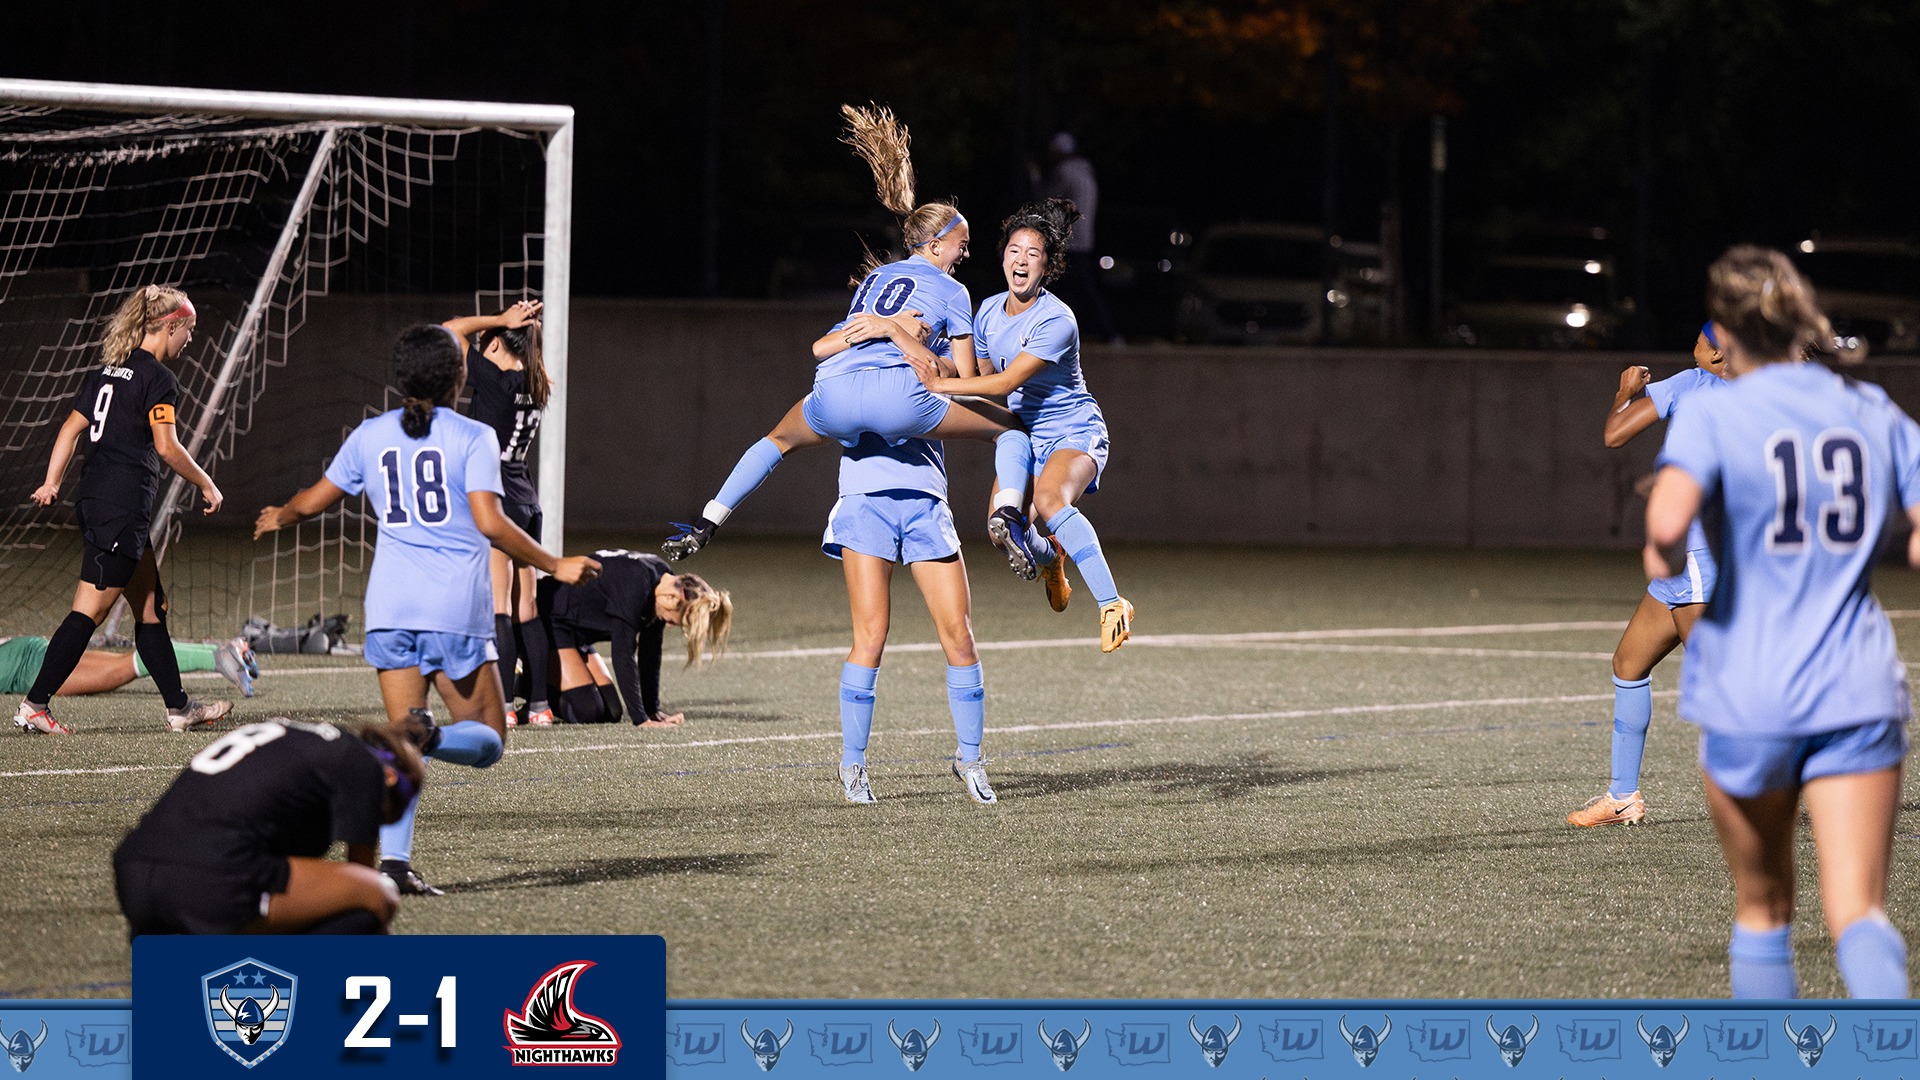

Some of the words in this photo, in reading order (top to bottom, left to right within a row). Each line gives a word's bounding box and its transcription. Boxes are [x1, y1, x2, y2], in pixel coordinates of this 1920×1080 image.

[847, 271, 918, 319] 10
[89, 383, 114, 442] 9
[152, 406, 165, 421] C
[378, 446, 452, 527] 18
[1765, 428, 1869, 554] 13
[190, 721, 287, 775] 8
